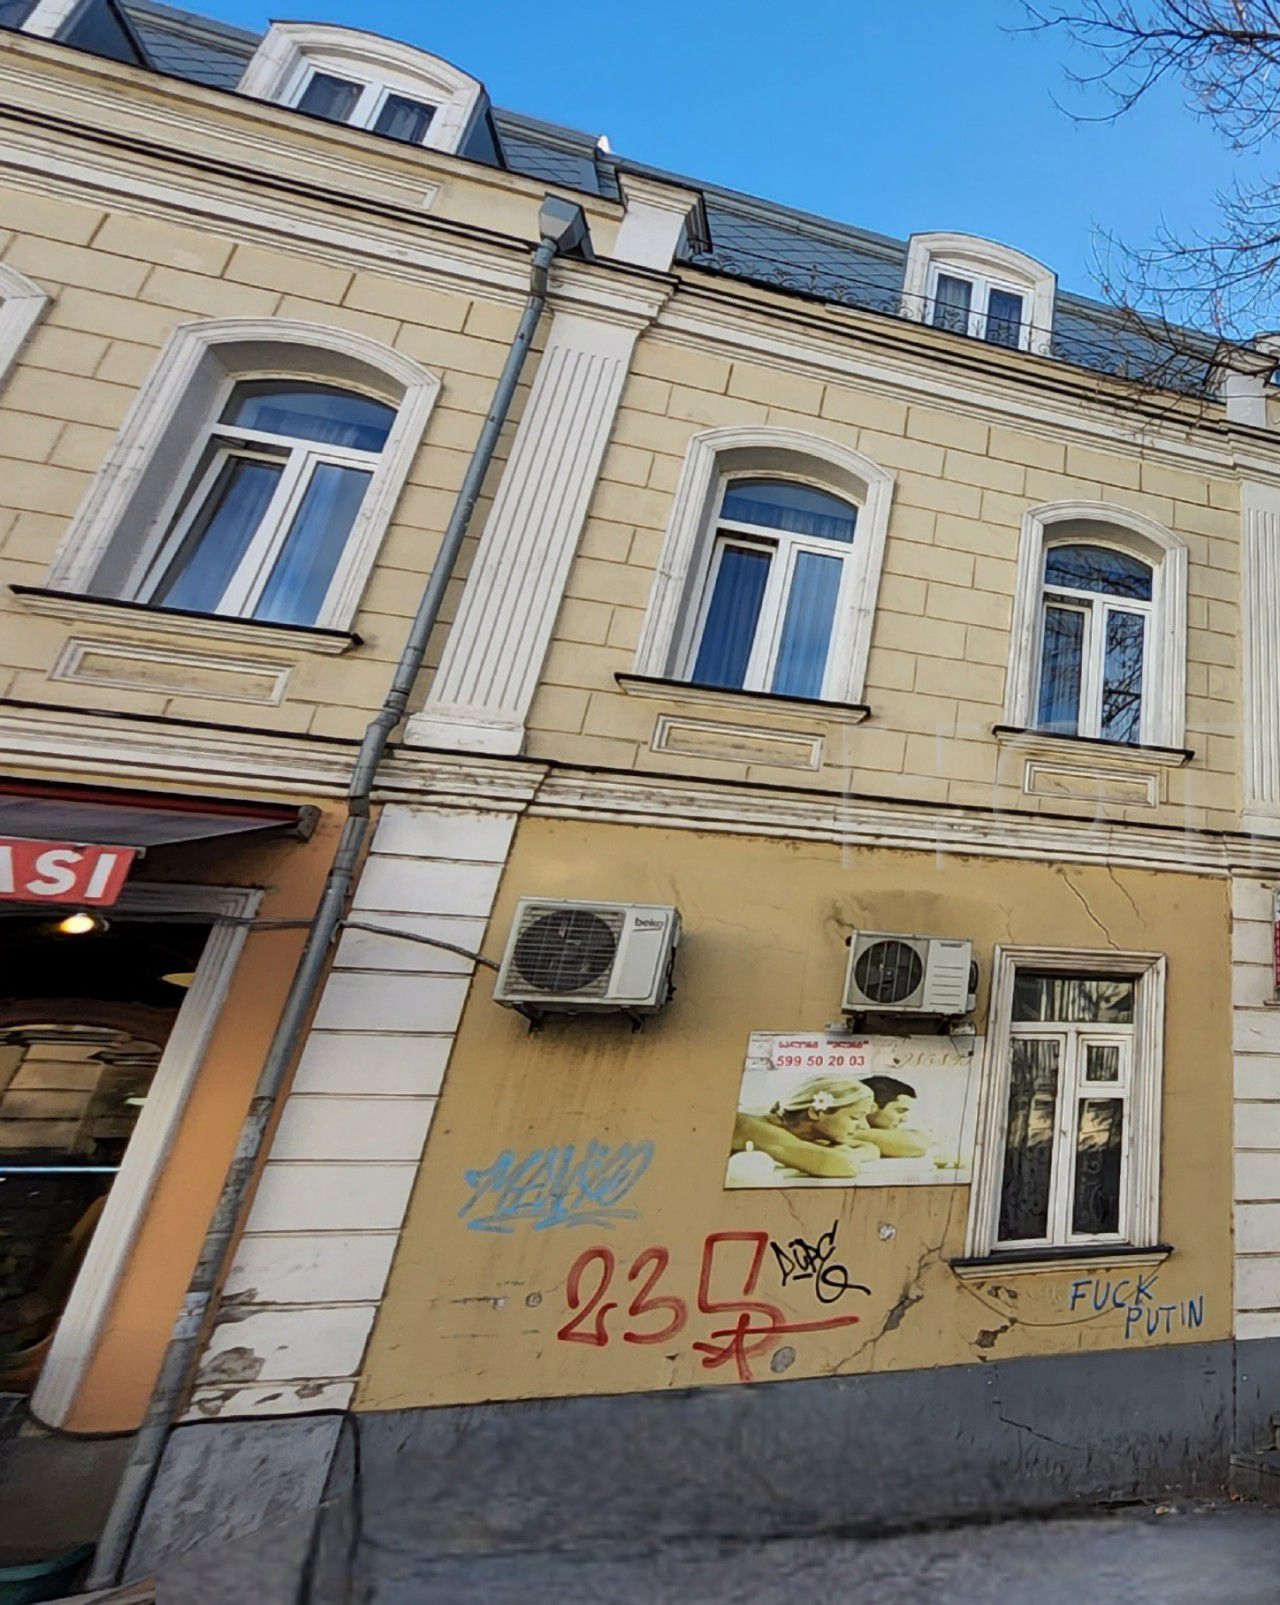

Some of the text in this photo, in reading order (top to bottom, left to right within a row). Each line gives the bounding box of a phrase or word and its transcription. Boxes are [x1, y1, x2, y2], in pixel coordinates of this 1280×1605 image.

[0, 846, 117, 898] SI
[635, 917, 664, 928] beko
[776, 1055, 865, 1067] 599 50 20 03
[1070, 1274, 1158, 1311] FUCK
[1125, 1295, 1204, 1339] PUTIN
